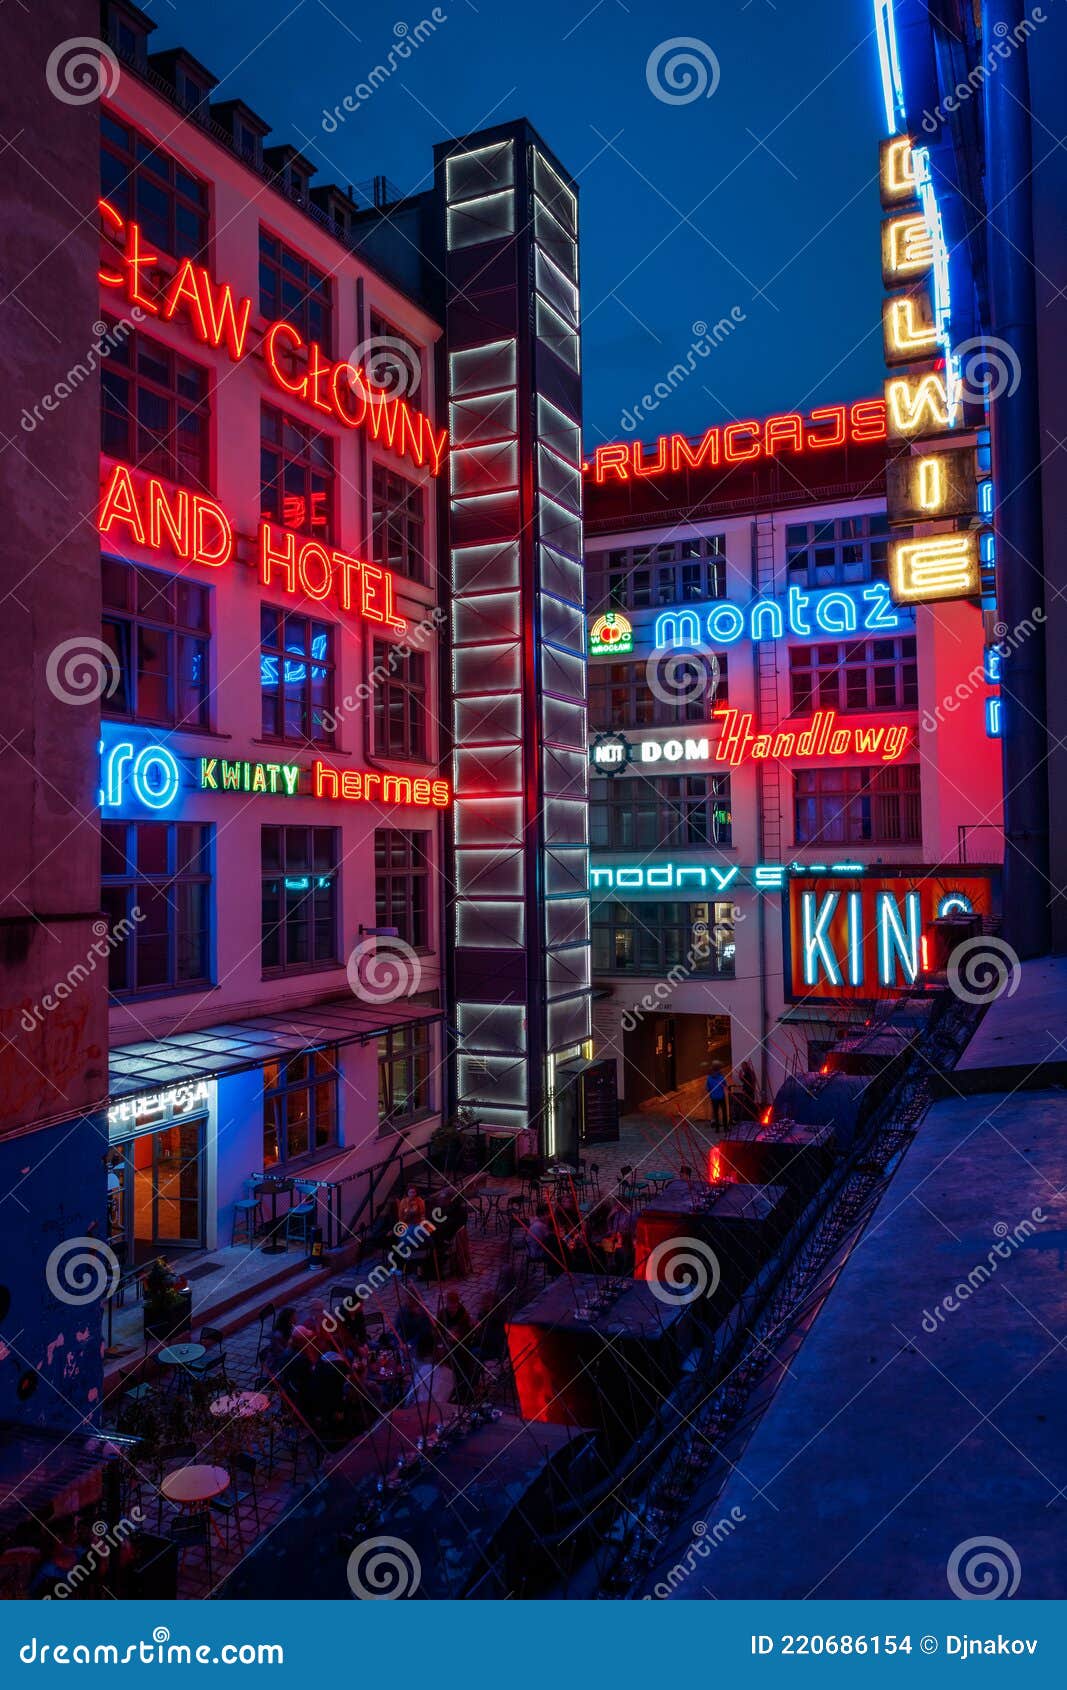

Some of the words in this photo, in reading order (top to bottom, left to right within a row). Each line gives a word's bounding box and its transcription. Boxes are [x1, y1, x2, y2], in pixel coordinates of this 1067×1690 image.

[265, 322, 448, 478] GŁÓWNY
[595, 399, 887, 484] RUMCAJS
[99, 465, 233, 567] AND
[261, 523, 407, 629] HOTEL
[655, 584, 898, 648] montaż
[641, 738, 709, 762] DOM
[713, 708, 909, 766] Handlowy
[201, 757, 299, 795] KWIATY
[314, 760, 450, 807] hermes
